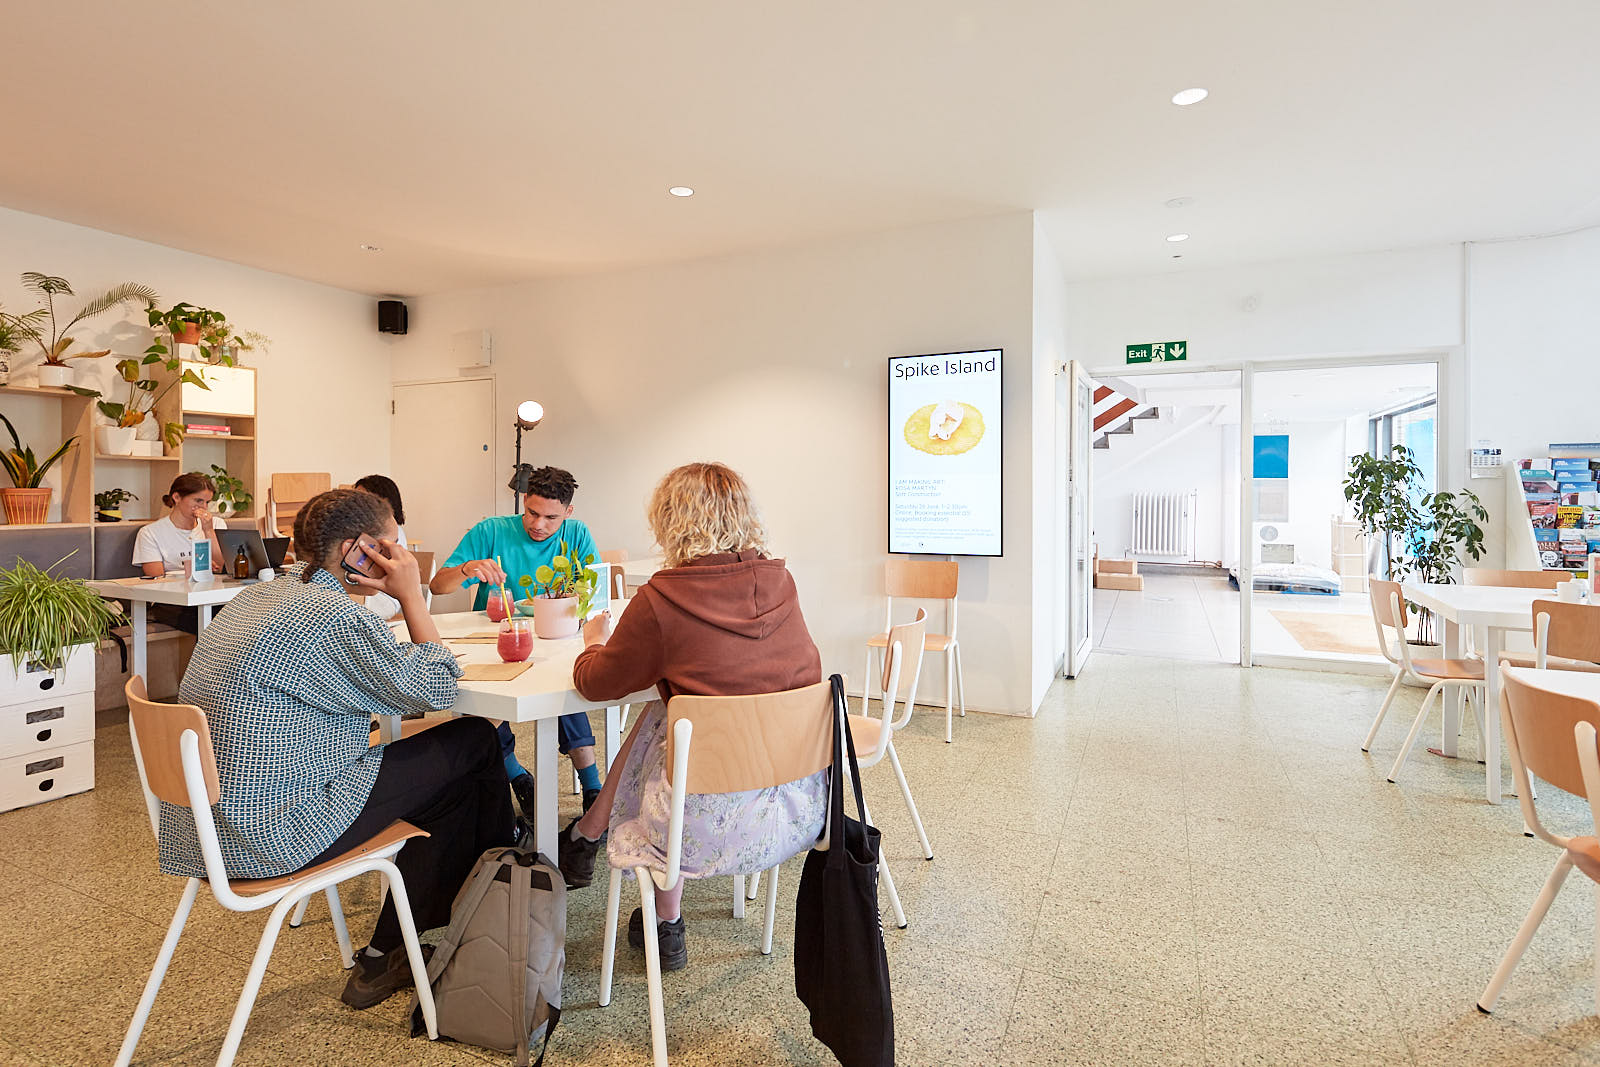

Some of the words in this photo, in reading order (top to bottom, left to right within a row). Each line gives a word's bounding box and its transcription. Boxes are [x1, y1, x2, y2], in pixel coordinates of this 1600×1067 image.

[1129, 349, 1147, 358] Exit
[895, 362, 940, 380] Spike
[945, 357, 995, 375] Island
